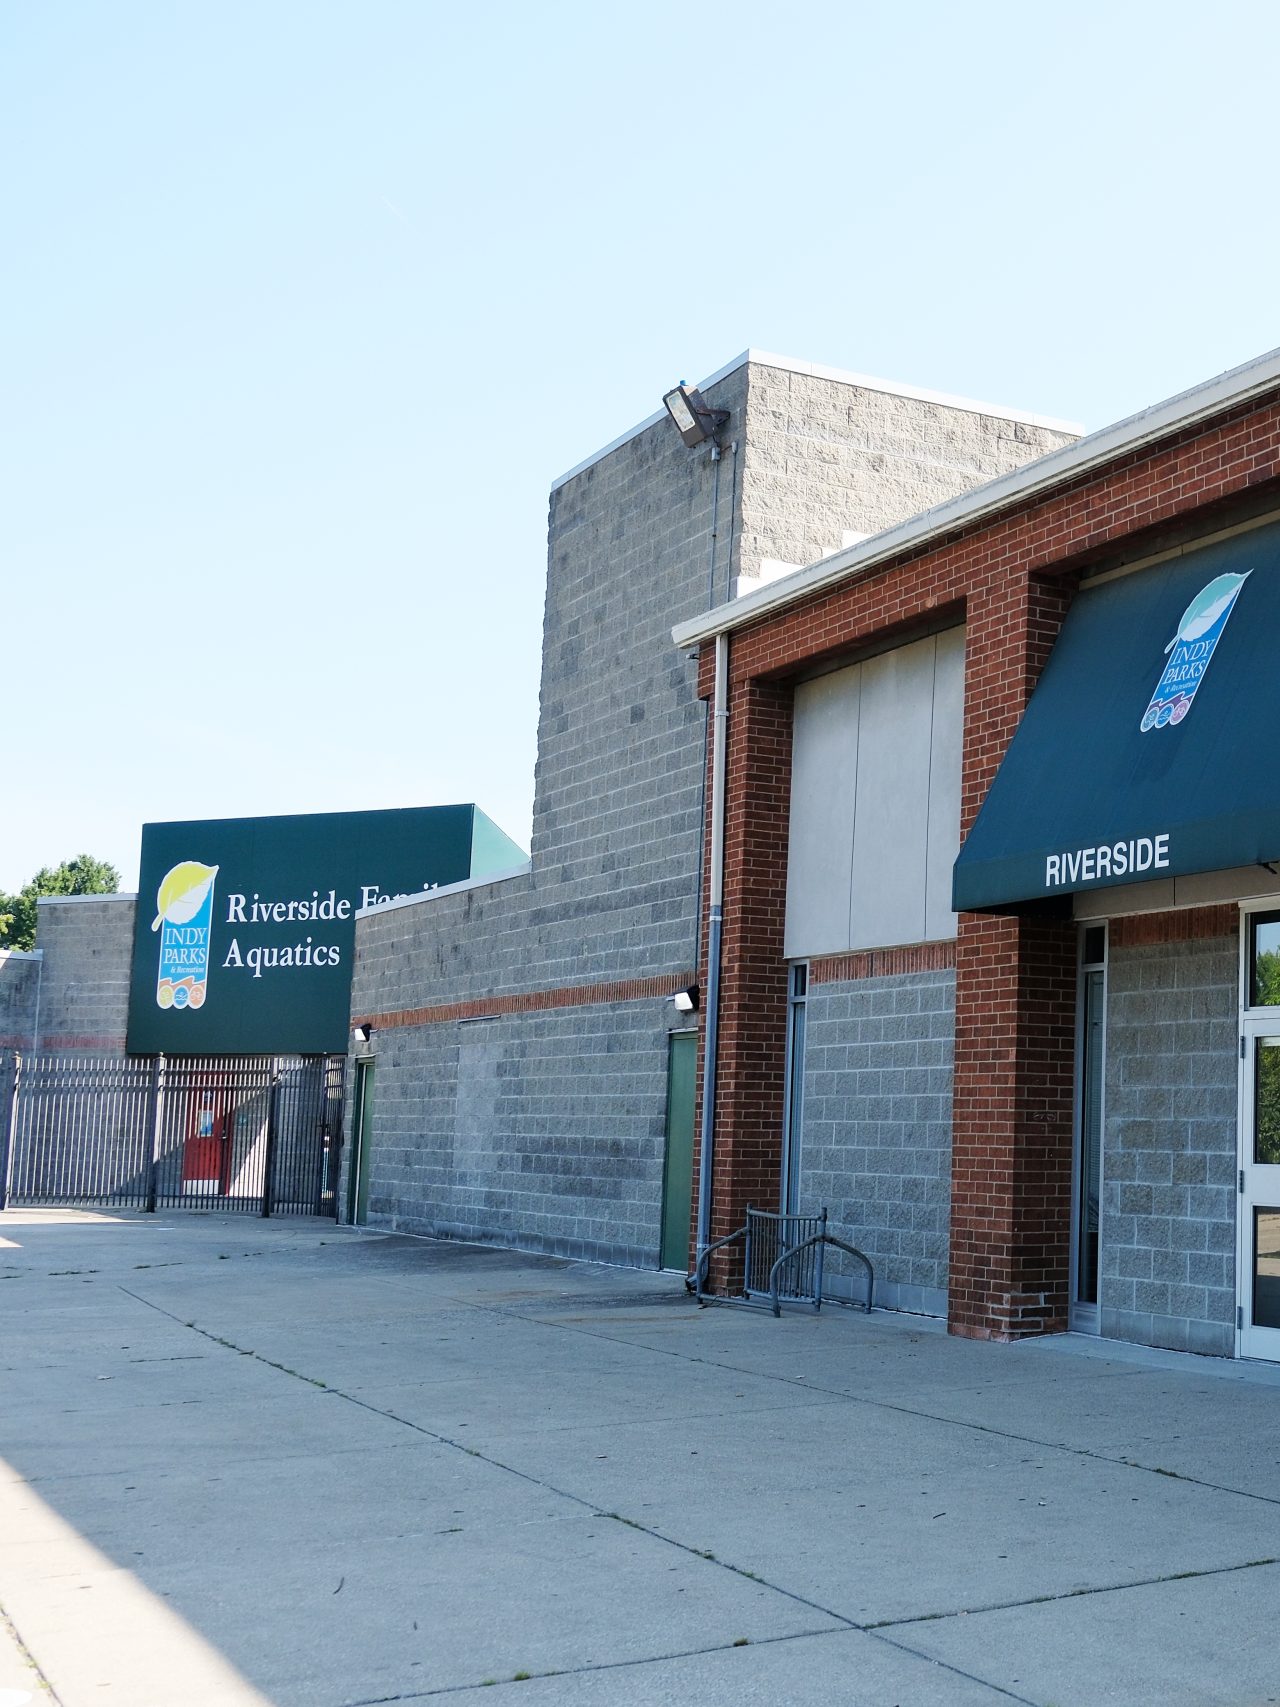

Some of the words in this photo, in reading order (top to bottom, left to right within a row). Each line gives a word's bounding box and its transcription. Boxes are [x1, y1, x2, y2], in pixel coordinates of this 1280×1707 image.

[1171, 639, 1216, 665] INDY
[1162, 660, 1207, 685] PARKS
[1045, 833, 1170, 887] RIVERSIDE
[226, 890, 351, 923] Riverside
[164, 927, 207, 945] INDY
[163, 947, 206, 965] PARKS
[222, 936, 341, 978] Aquatics
